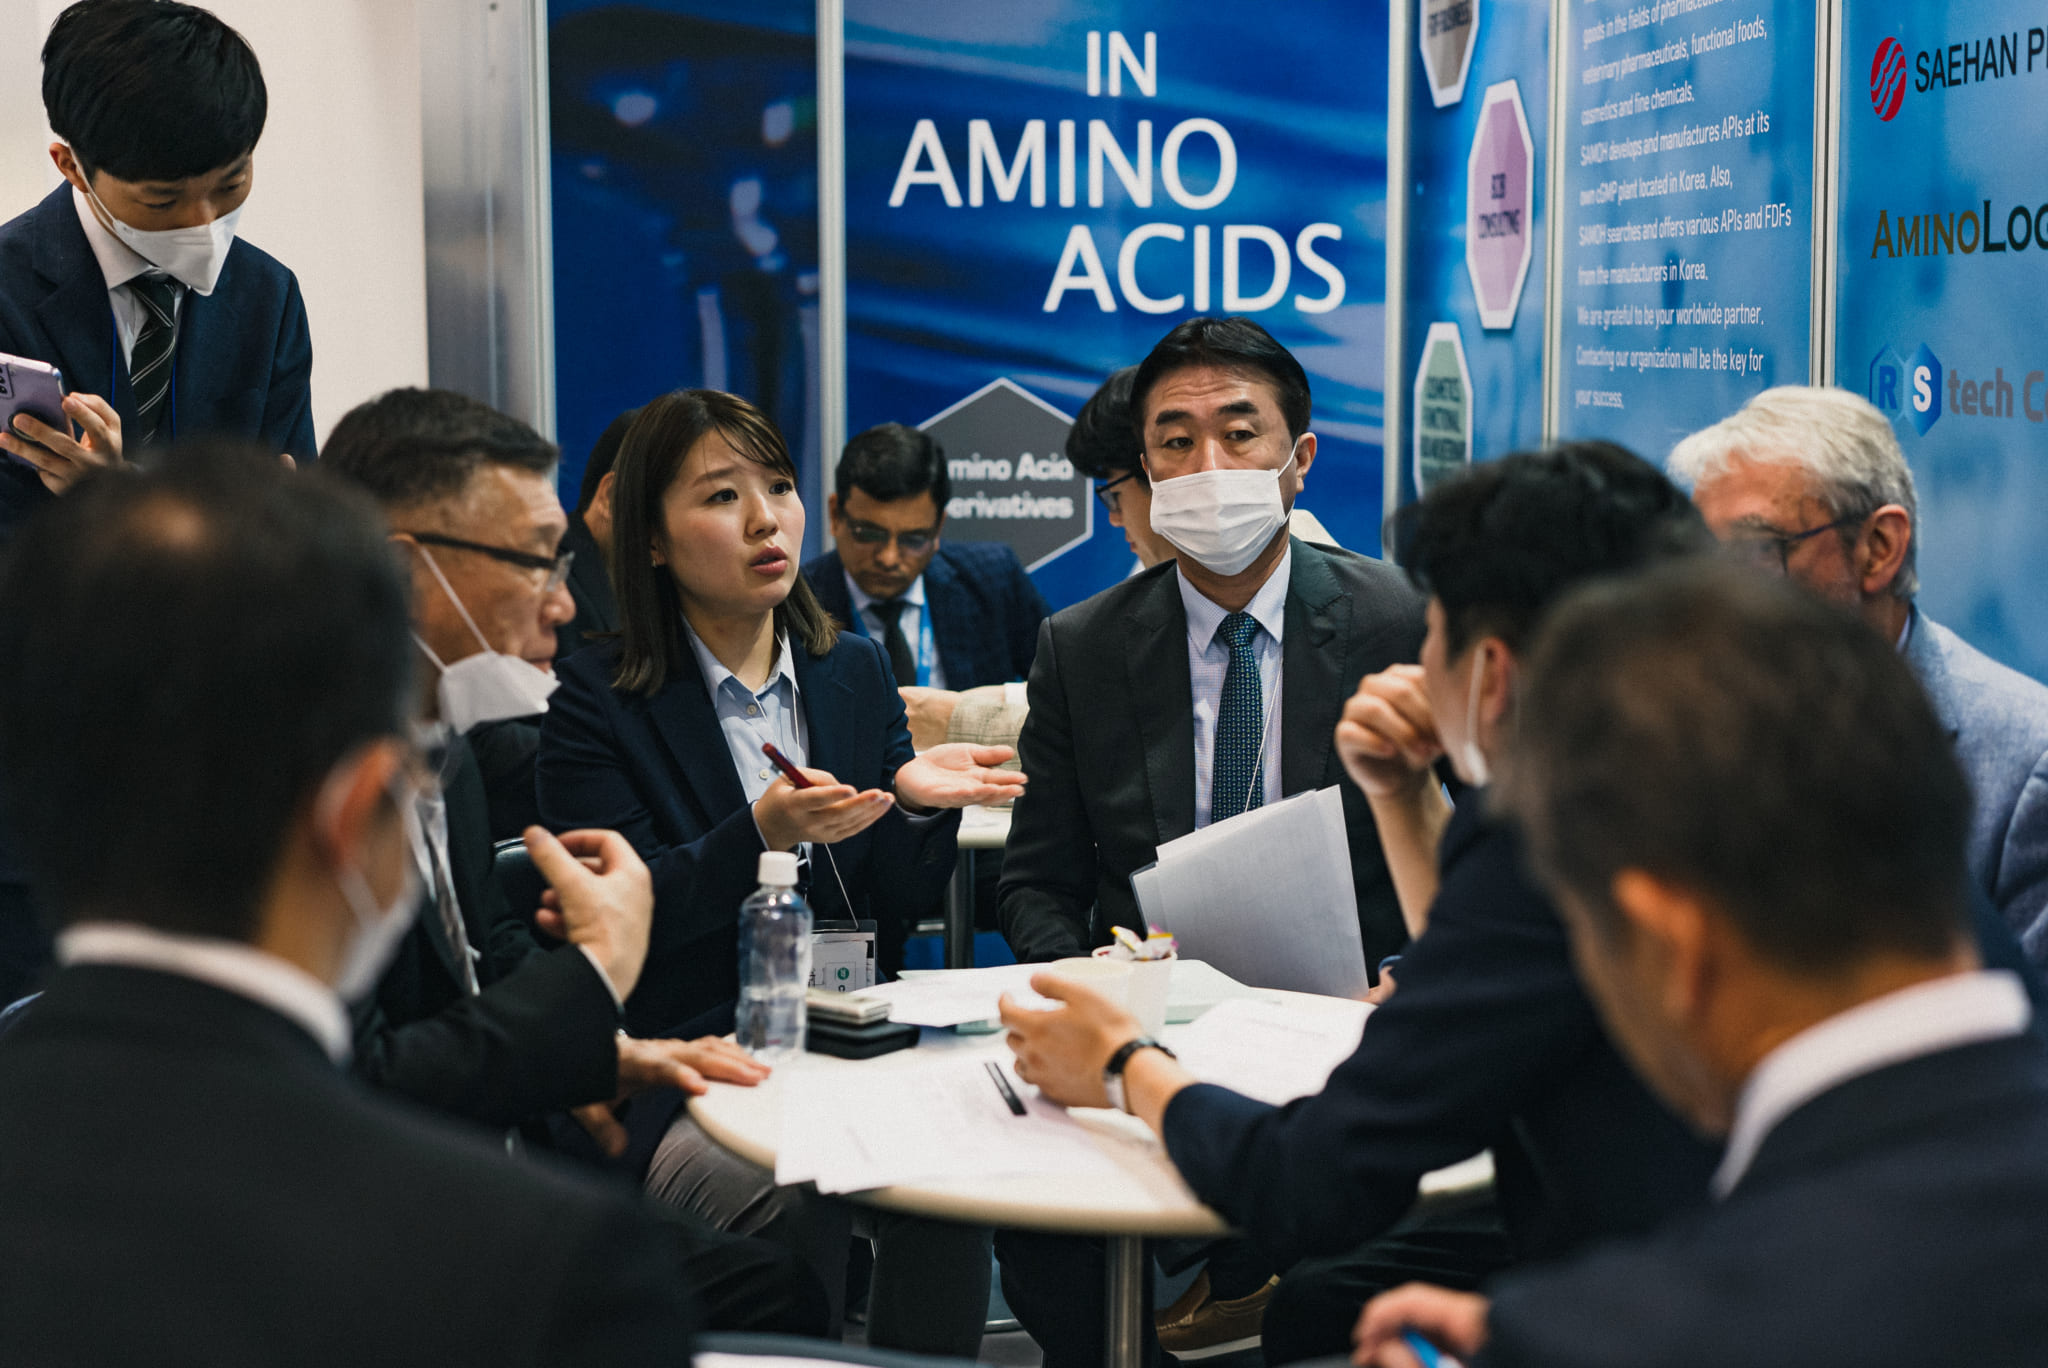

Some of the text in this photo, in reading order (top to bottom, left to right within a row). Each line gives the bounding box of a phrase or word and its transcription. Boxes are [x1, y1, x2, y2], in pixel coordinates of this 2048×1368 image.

[1606, 17, 1614, 37] in
[1615, 13, 1627, 35] the
[1628, 5, 1650, 31] fields
[1651, 0, 1660, 24] of
[1087, 31, 1157, 97] IN
[1621, 36, 1690, 80] pharmaceuticals,
[1691, 20, 1736, 54] functional
[1737, 14, 1768, 42] foods,
[1915, 26, 2048, 93] SAEHAN P
[1582, 99, 1618, 126] cosmetics
[1619, 93, 1633, 117] and
[1634, 91, 1649, 114] fine
[1609, 136, 1642, 162] develops
[1644, 130, 1659, 154] and
[1660, 123, 1720, 151] manufactures
[1721, 114, 1743, 142] APIs
[1745, 112, 1755, 135] at
[1757, 109, 1769, 134] its
[889, 118, 1238, 210] AMINO
[1618, 178, 1638, 206] plant
[1639, 172, 1667, 198] located
[1669, 170, 1678, 193] in
[1710, 164, 1733, 190] Also,
[1608, 220, 1641, 244] searches
[1643, 217, 1658, 241] and
[1659, 215, 1684, 239] offers
[1685, 213, 1719, 235] various
[1720, 208, 1742, 233] APIs
[1744, 205, 1763, 229] and
[1765, 202, 1792, 228] FDFs
[1042, 223, 1347, 314] ACIDS
[1578, 258, 1708, 286] from the manufacturers in Korea.
[1577, 303, 1764, 331] We are grateful to be your worldwide partner.
[1576, 345, 1763, 376] Contacting our organization will be the key for
[1575, 390, 1592, 409] your
[1947, 367, 2014, 418] tech
[2023, 370, 2048, 423] C
[947, 452, 1012, 481] mino
[946, 490, 1074, 519] erivatives
